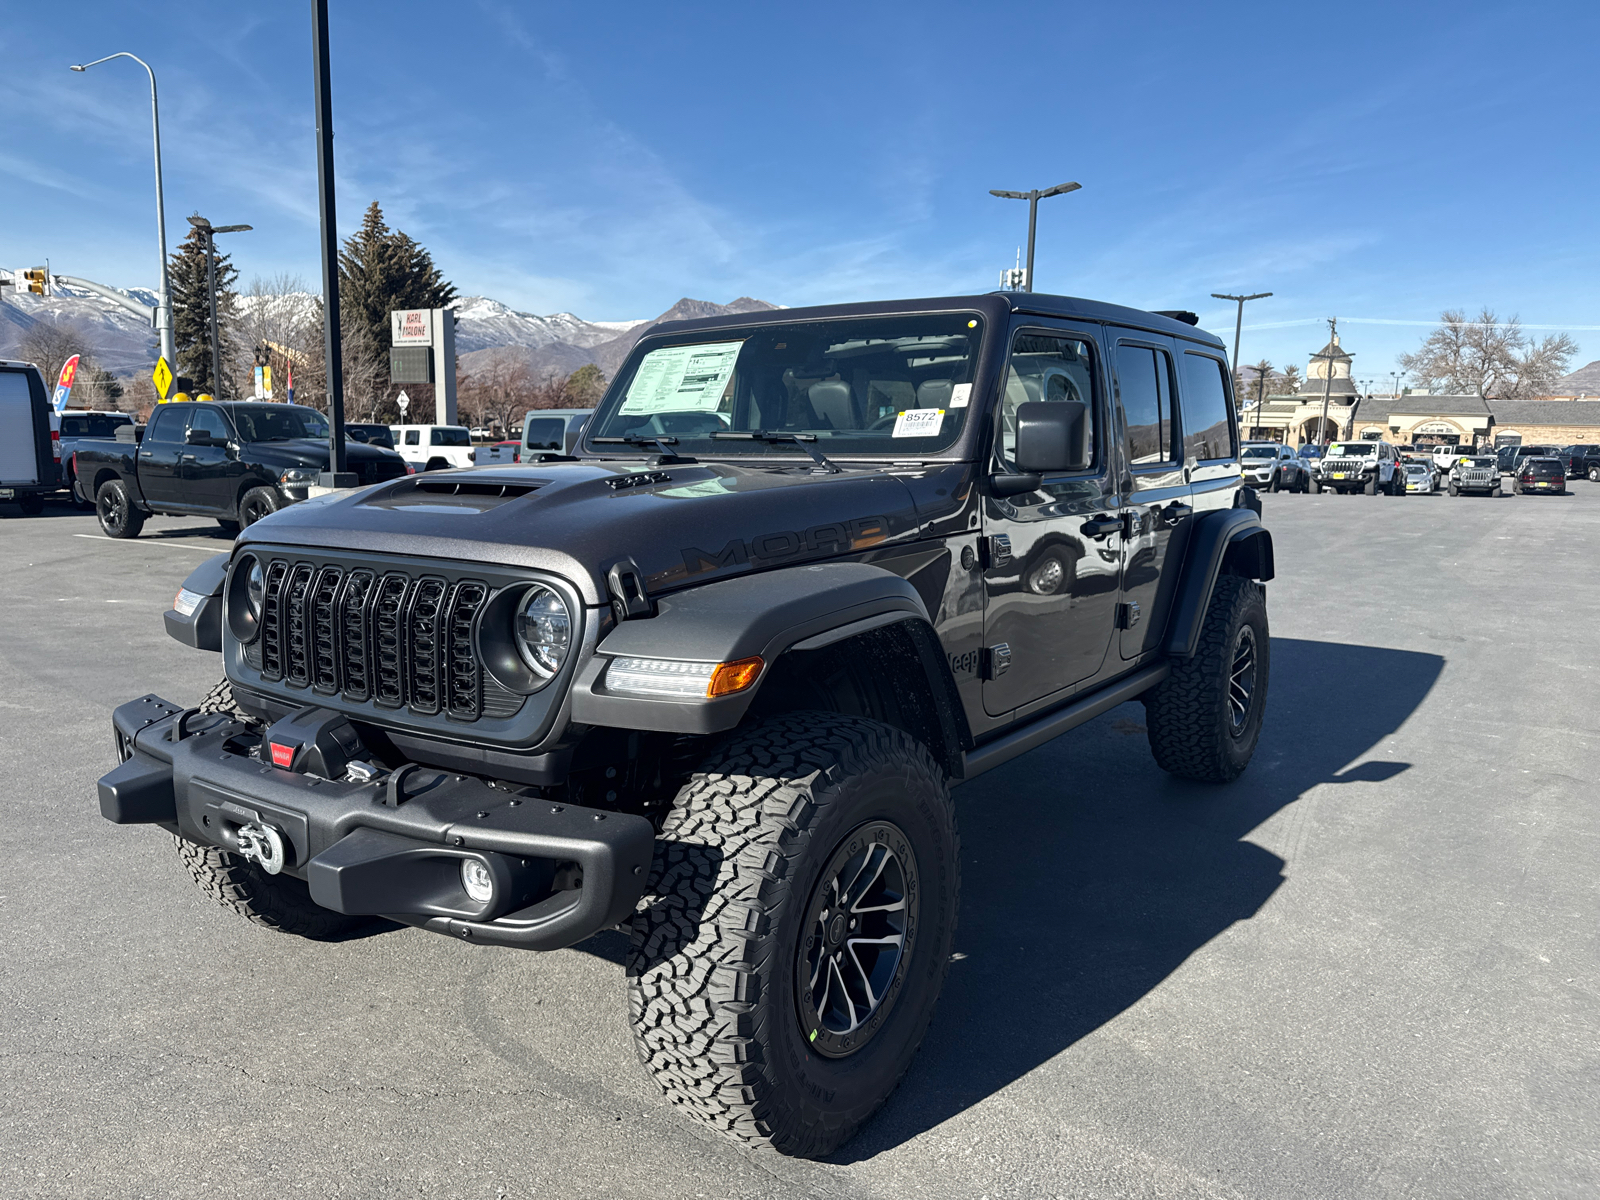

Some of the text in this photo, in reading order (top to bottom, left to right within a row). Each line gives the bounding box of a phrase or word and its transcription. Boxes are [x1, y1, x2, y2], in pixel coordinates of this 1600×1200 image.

[406, 313, 421, 324] KARL
[402, 325, 426, 336] MALONE
[905, 412, 936, 422] 8572
[680, 515, 889, 574] MOAB
